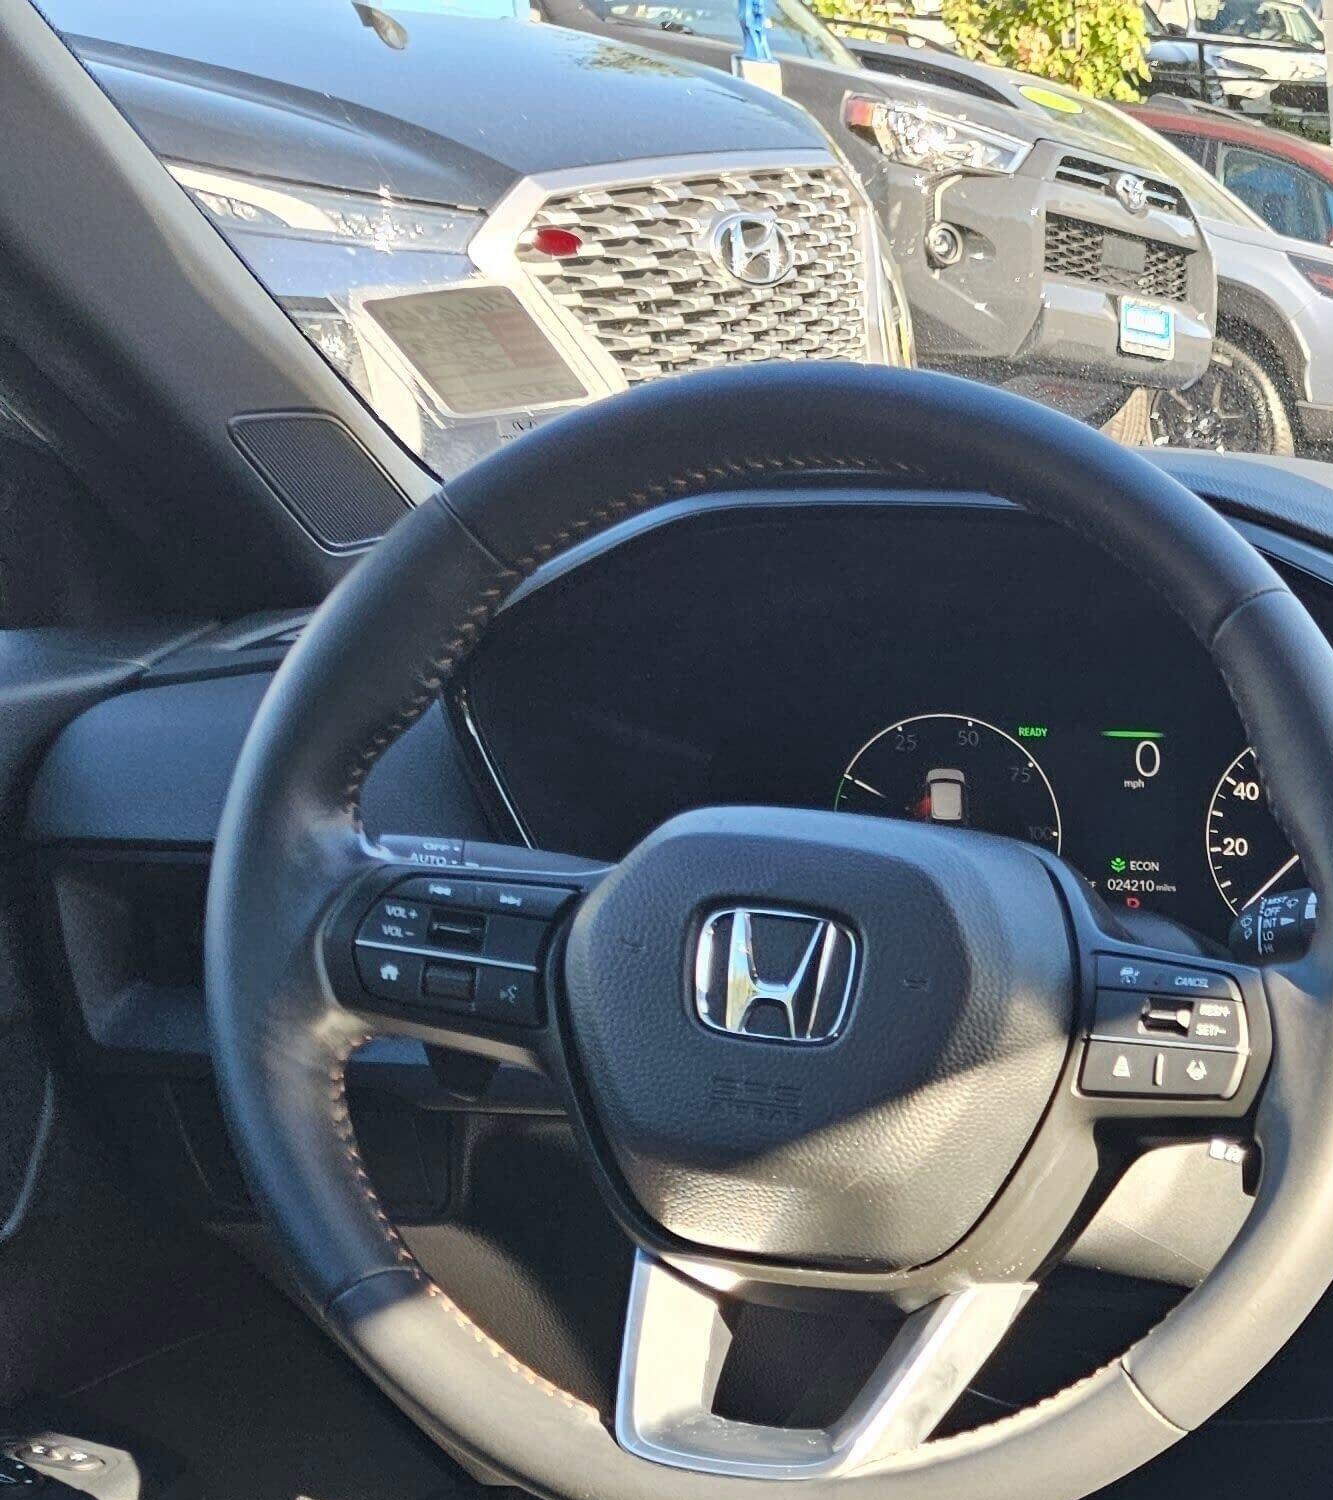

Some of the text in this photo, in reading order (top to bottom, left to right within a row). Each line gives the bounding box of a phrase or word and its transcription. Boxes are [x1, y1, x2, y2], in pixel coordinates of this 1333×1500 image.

[1018, 726, 1048, 737] READY
[895, 734, 917, 751] 25
[958, 730, 979, 747] 50
[1135, 740, 1161, 778] 0
[1009, 767, 1031, 783] 75
[1123, 779, 1145, 789] mph
[1233, 782, 1260, 801] 40
[1222, 837, 1249, 856] 20
[410, 852, 447, 866] AUTO
[1129, 860, 1160, 872] ECON
[1107, 879, 1176, 892] 024210 miles
[385, 905, 407, 919] VOL
[1264, 906, 1281, 918] OFF
[1263, 918, 1278, 929] INT
[382, 925, 404, 938] VOL
[1263, 931, 1274, 941] LO
[1174, 976, 1209, 988] CANCEL
